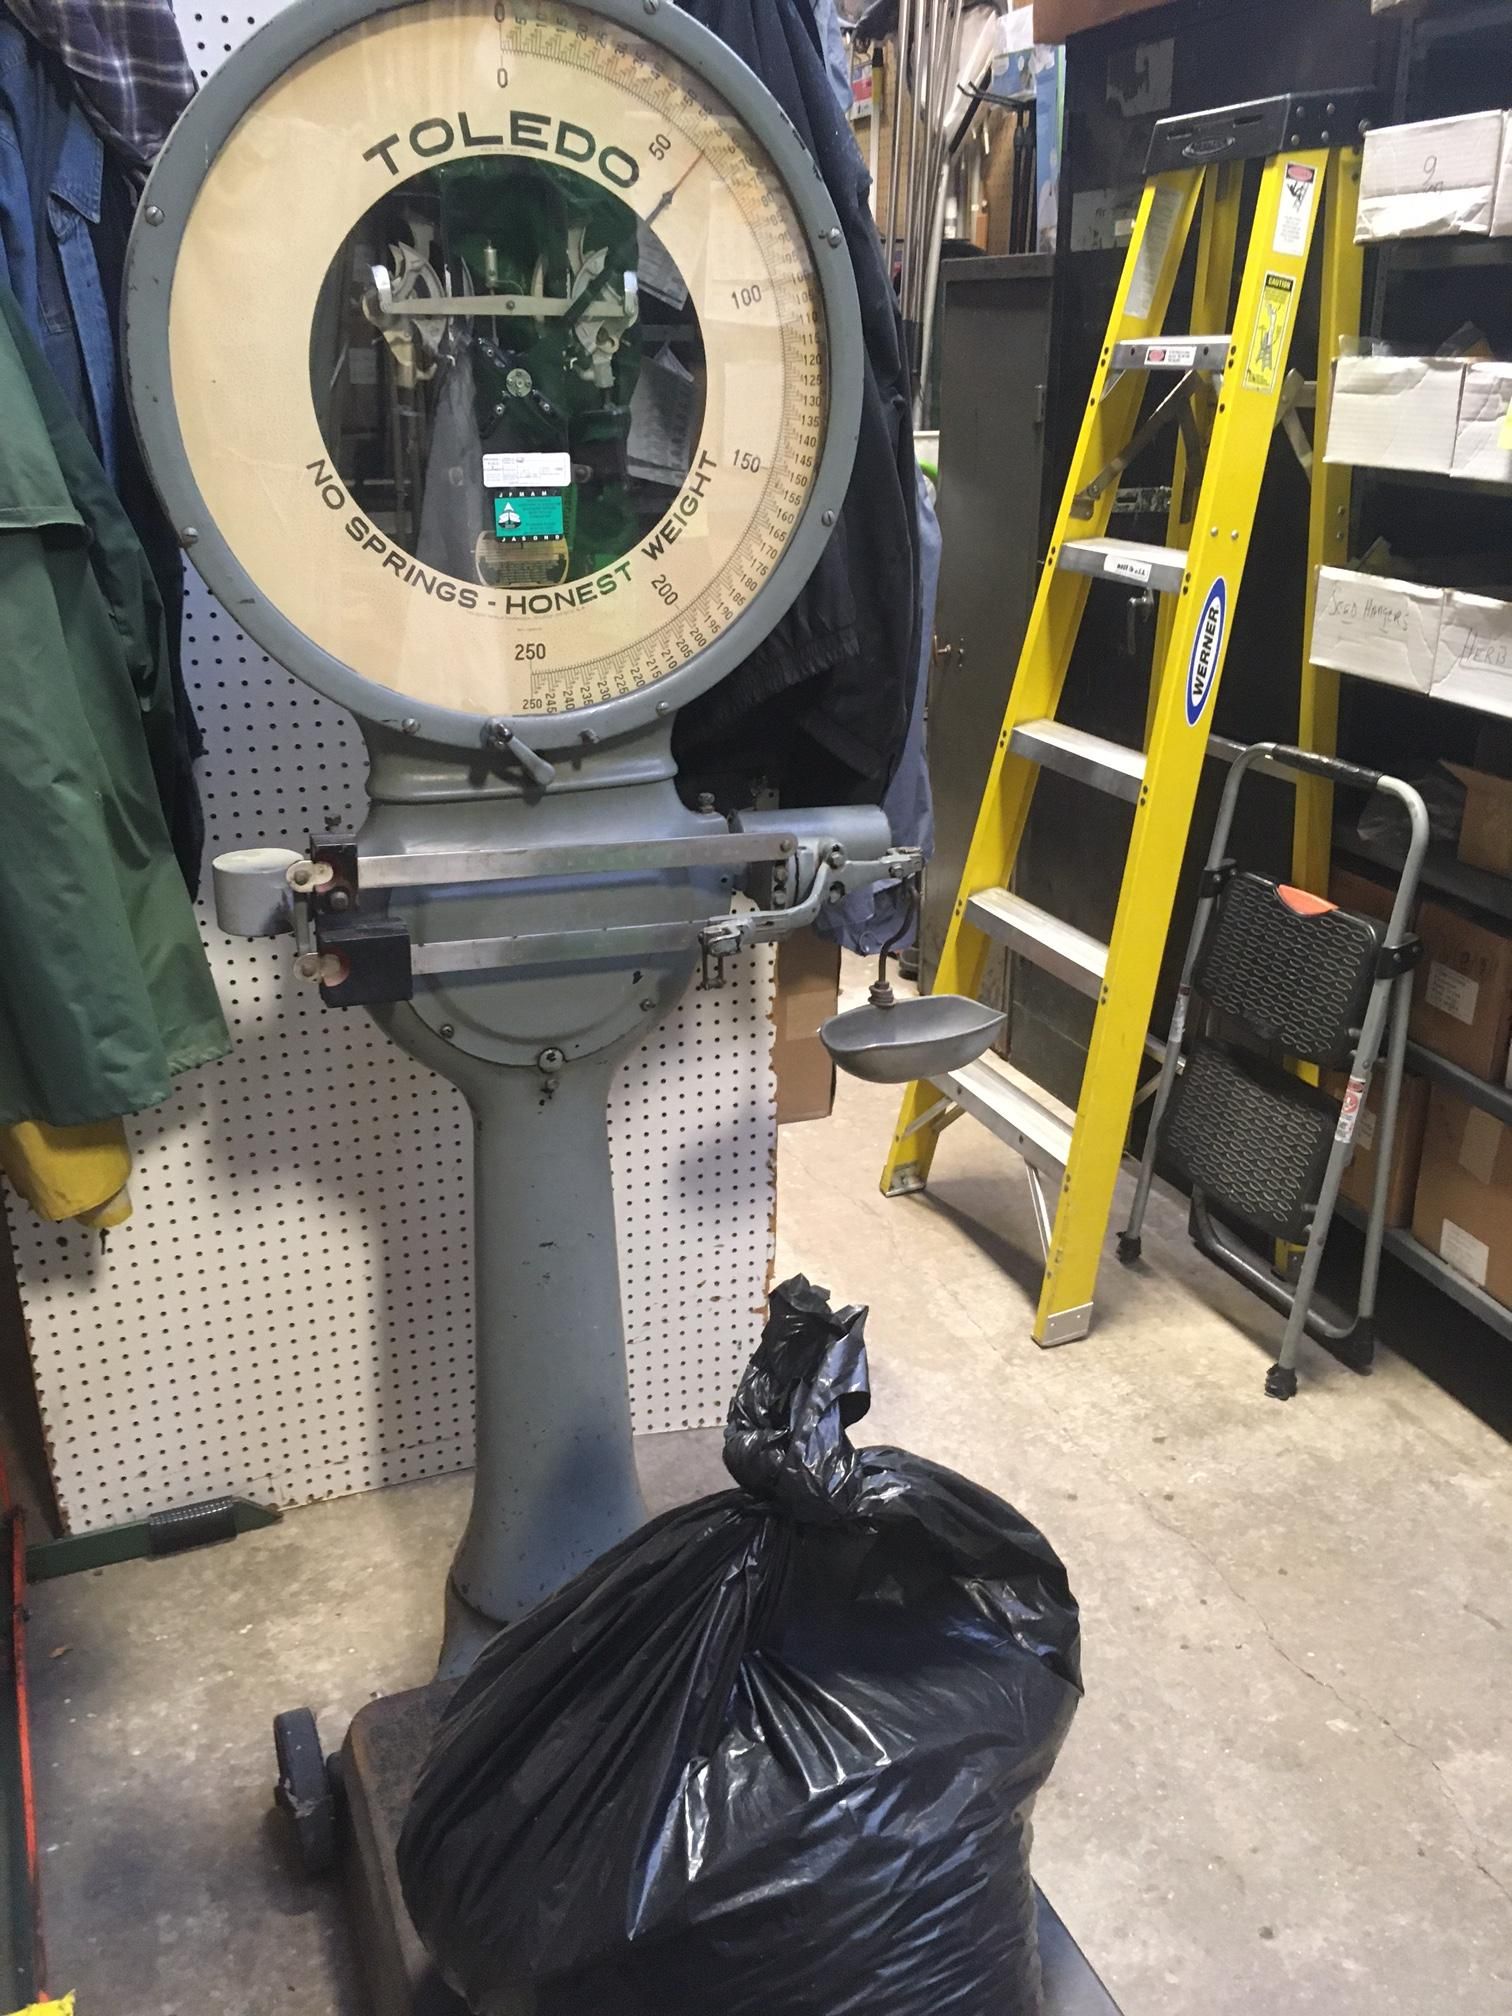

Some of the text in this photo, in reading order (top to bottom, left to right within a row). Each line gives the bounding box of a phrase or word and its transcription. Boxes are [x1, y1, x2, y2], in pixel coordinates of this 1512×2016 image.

[494, 2, 505, 23] 0
[576, 22, 589, 41] 20
[497, 67, 508, 88] 0
[683, 88, 698, 107] 50
[361, 109, 640, 189] TOLEDO
[648, 133, 672, 161] 50
[731, 284, 762, 310] 100
[800, 311, 818, 326] 110
[804, 353, 822, 367] 120
[803, 374, 823, 387] 125
[803, 395, 822, 408] 130
[801, 414, 820, 428] 135
[799, 434, 817, 448] 140
[733, 448, 761, 473] 150
[794, 453, 813, 468] 145
[789, 472, 808, 488] 150
[783, 489, 802, 506] 155
[776, 507, 795, 525] 160
[306, 458, 346, 510] NO
[344, 515, 479, 609] SPRINGS
[505, 560, 633, 615] HONEST
[641, 449, 718, 562] WEIGHT
[768, 525, 788, 542] 165
[760, 542, 778, 560] 170
[750, 558, 769, 576] 175
[651, 574, 679, 606] 200
[740, 573, 758, 592] 180
[728, 588, 747, 606] 185
[716, 602, 734, 621] 190
[703, 614, 721, 634] 195
[690, 627, 707, 647] 200
[514, 643, 546, 661] 250
[676, 639, 694, 658] 205
[1193, 606, 1219, 696] WERNER
[646, 658, 663, 679] 215
[661, 649, 678, 669] 210
[614, 674, 630, 695] 225
[630, 666, 646, 688] 220
[580, 686, 594, 707] 235
[597, 680, 612, 701] 230
[522, 698, 543, 710] 250
[545, 693, 558, 714] 245
[562, 690, 576, 711] 240
